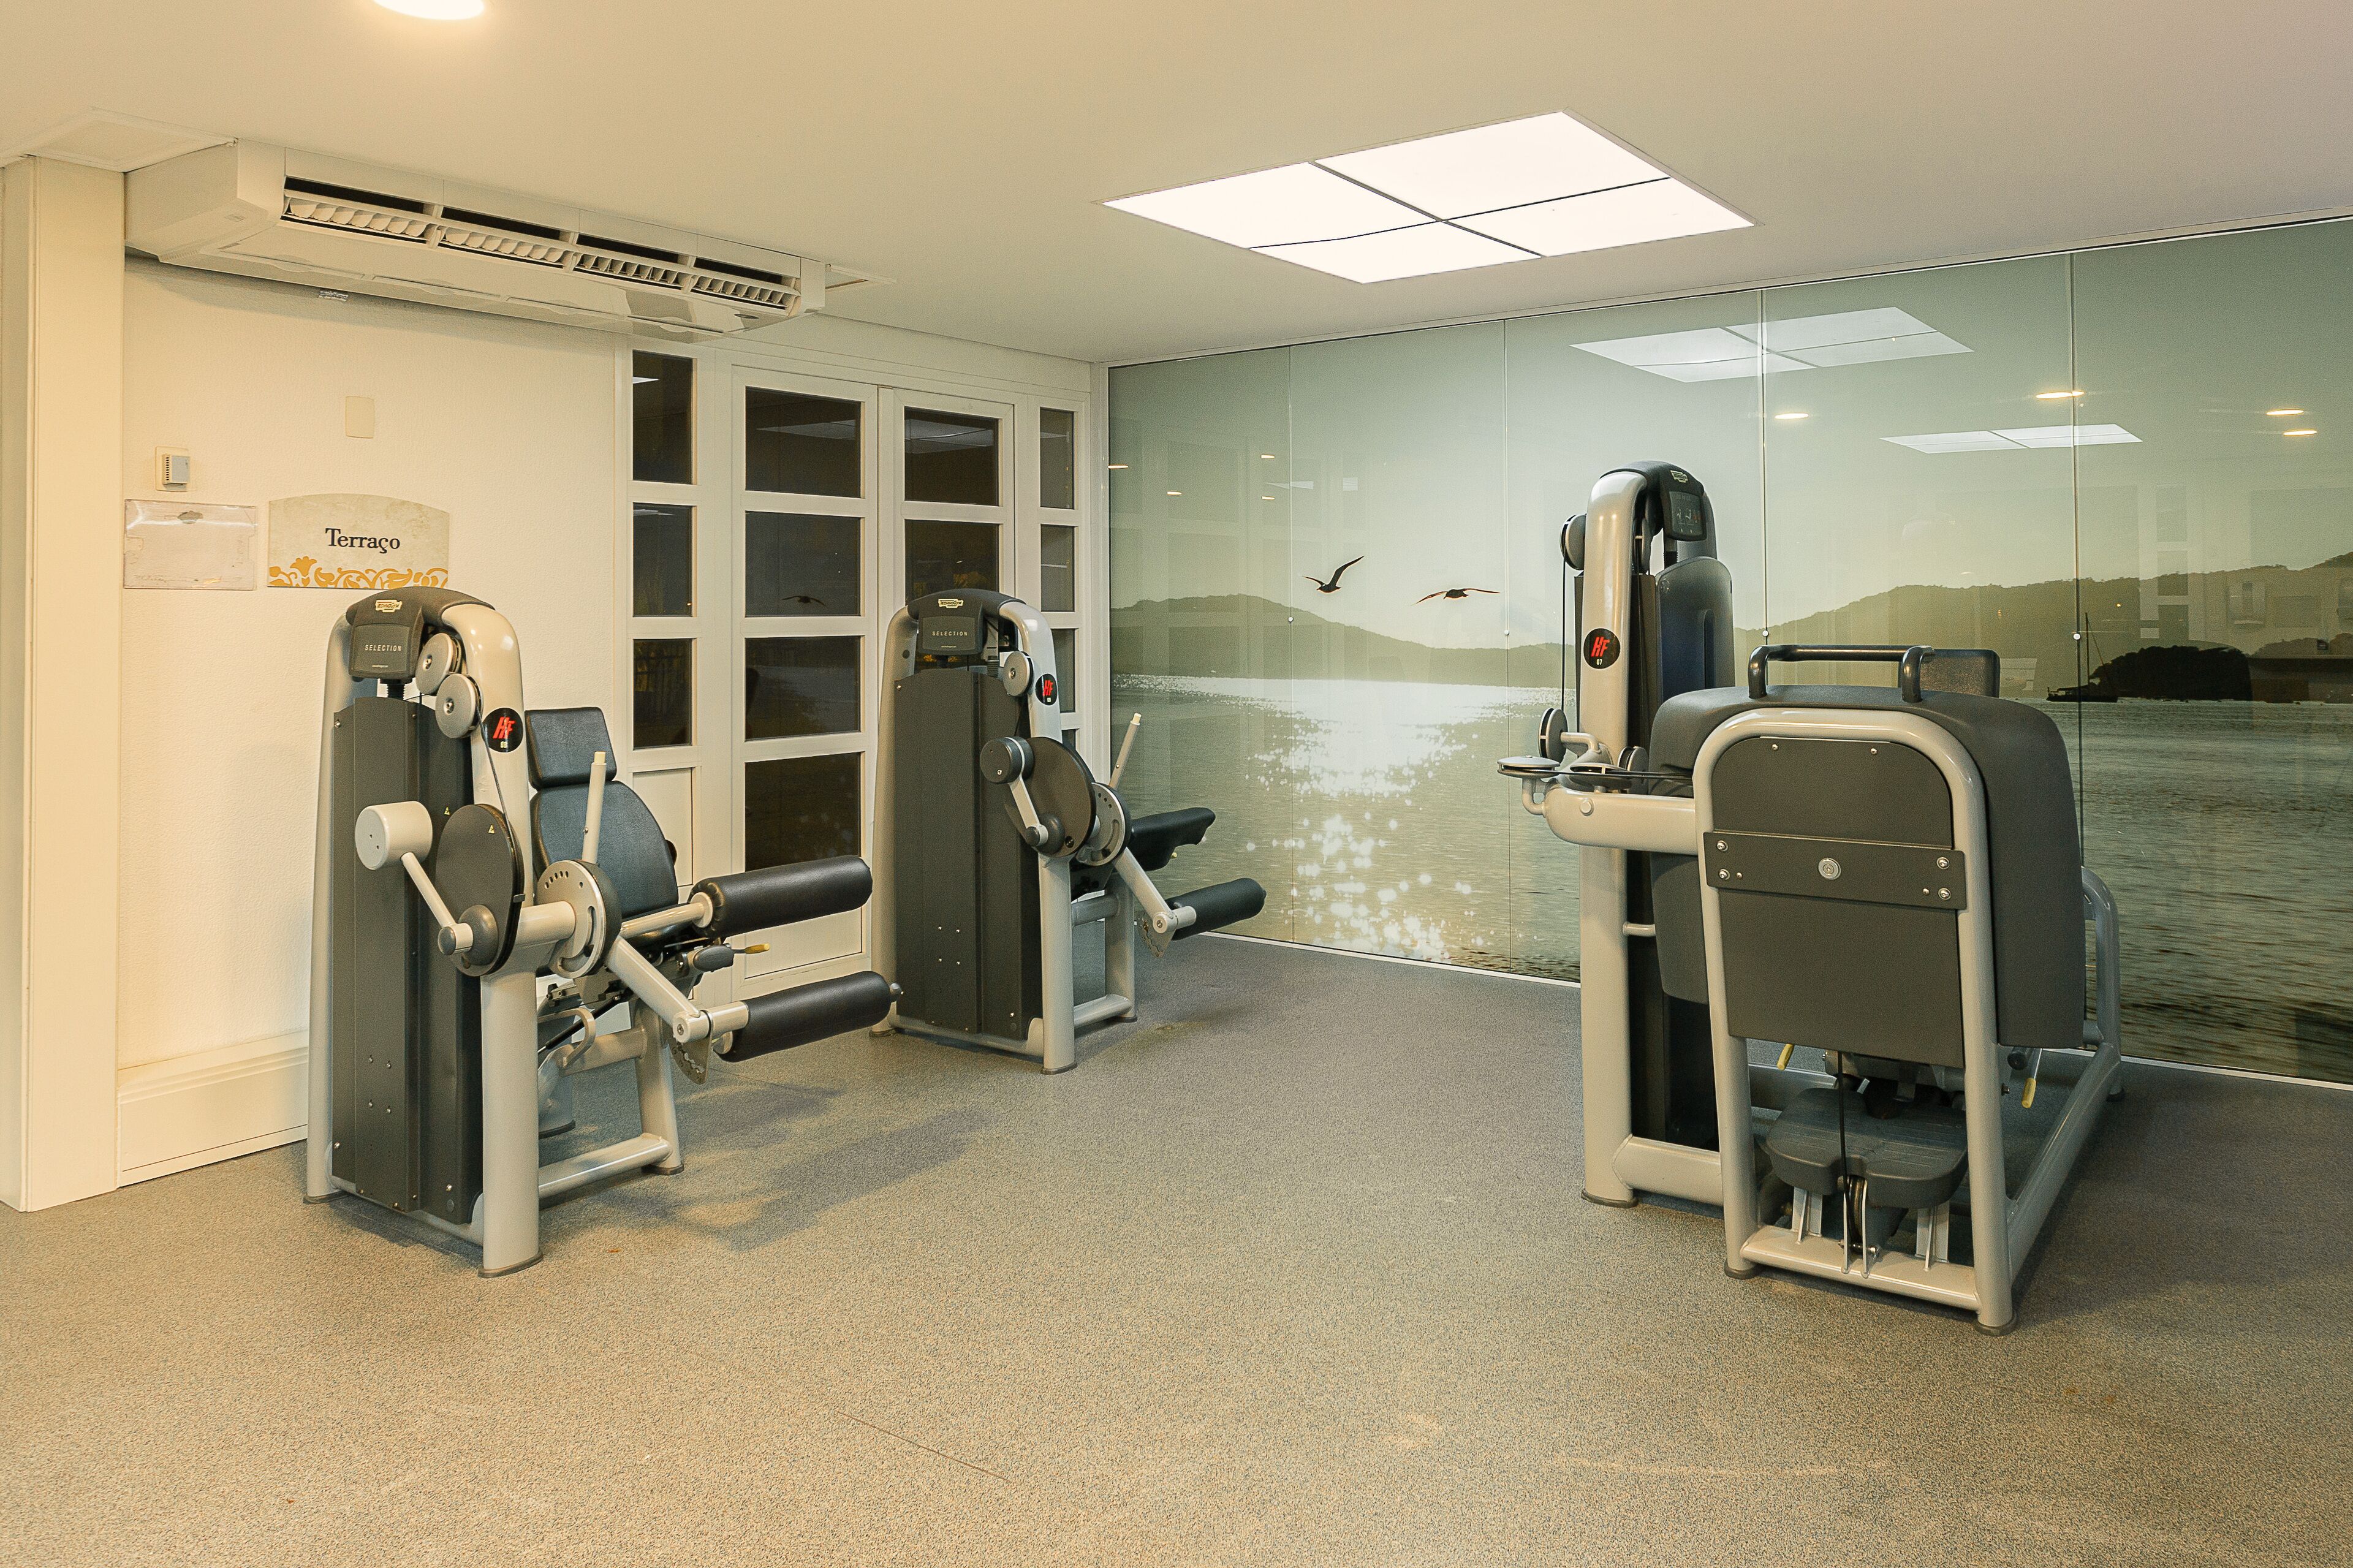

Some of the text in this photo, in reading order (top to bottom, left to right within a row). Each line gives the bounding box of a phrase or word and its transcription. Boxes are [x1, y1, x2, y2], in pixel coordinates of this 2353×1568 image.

[325, 528, 401, 554] Terraço
[1591, 637, 1610, 657] HF
[493, 716, 515, 739] HF
